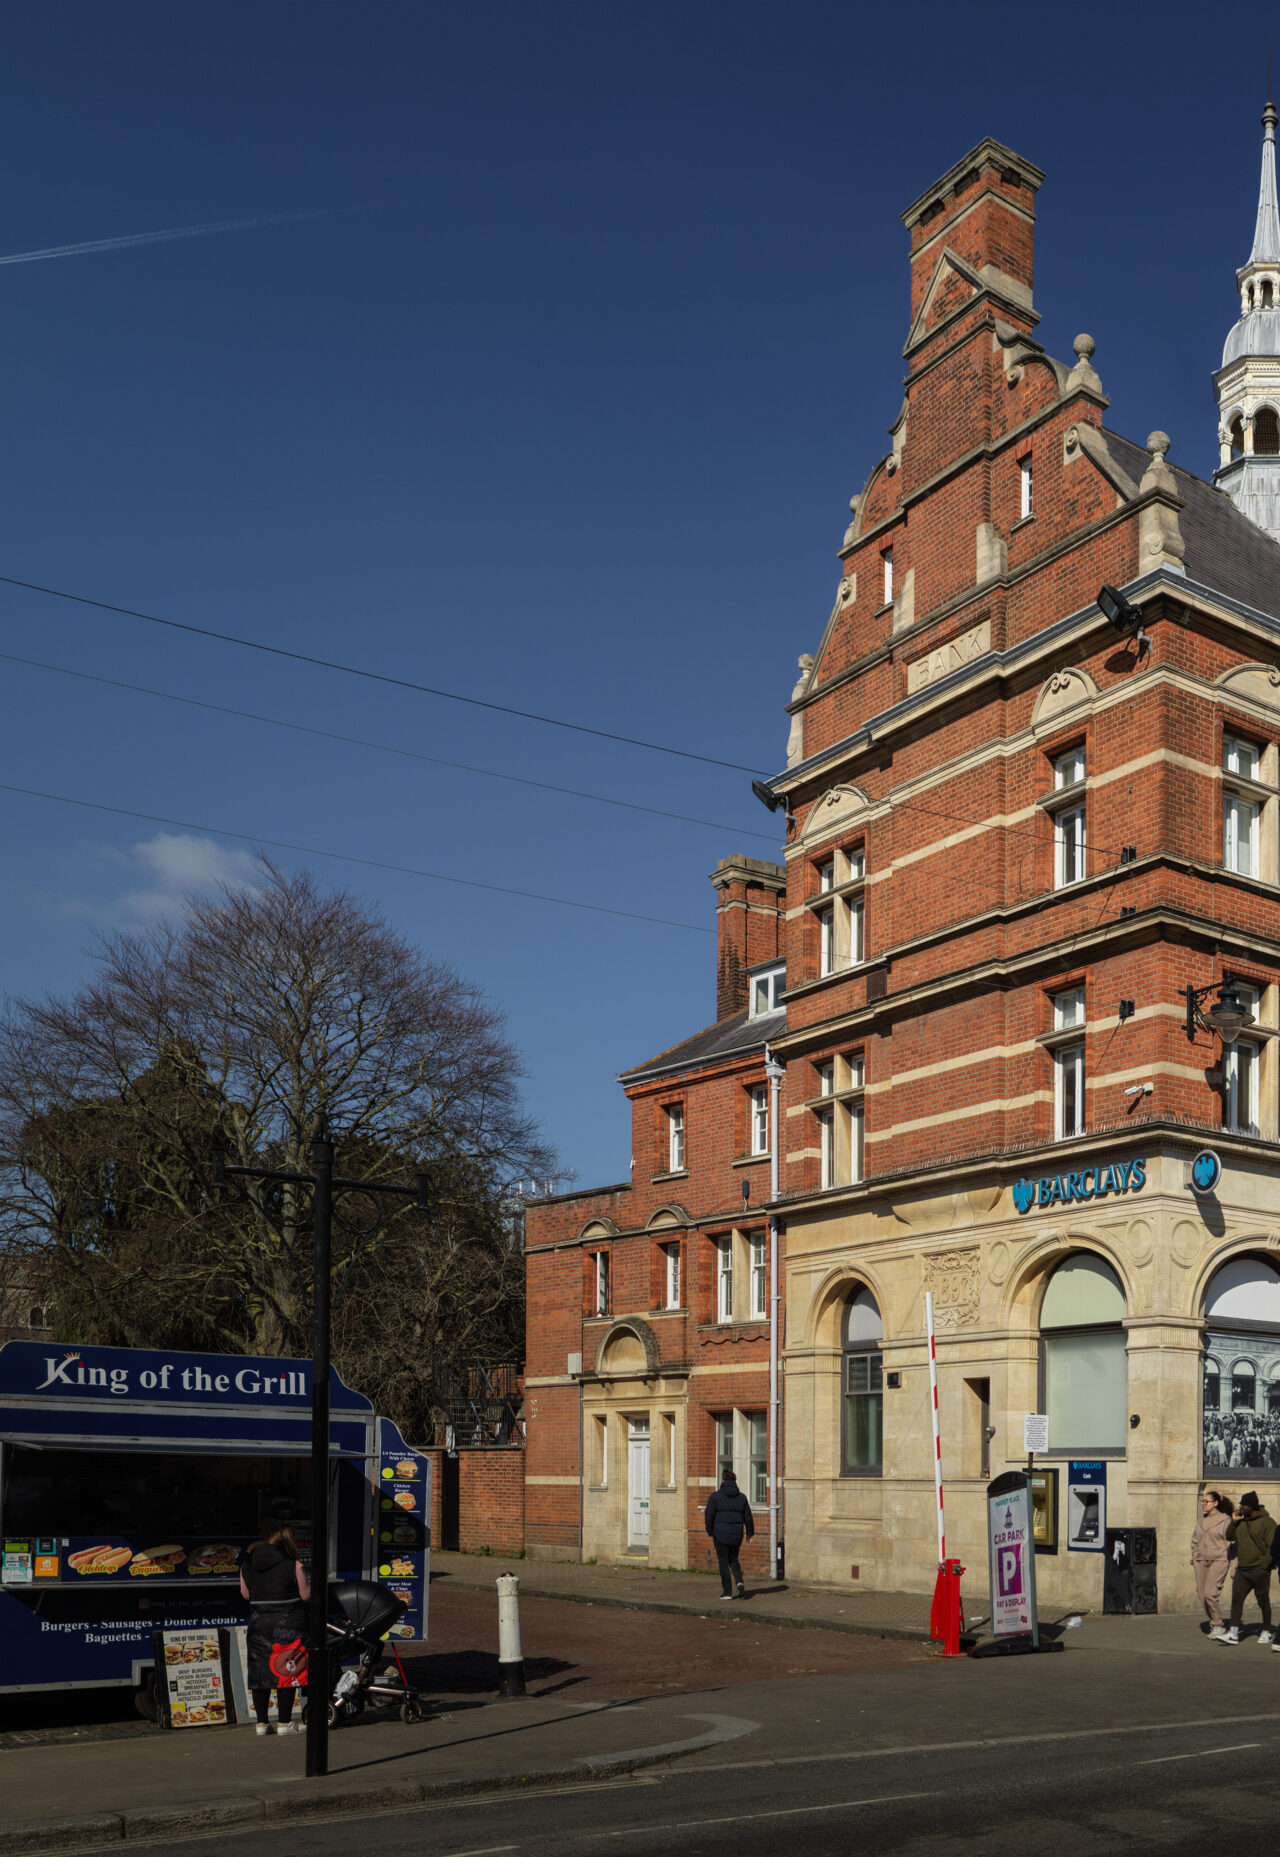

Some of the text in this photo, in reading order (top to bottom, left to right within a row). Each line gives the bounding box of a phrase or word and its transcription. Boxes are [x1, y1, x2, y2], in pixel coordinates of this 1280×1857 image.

[916, 628, 983, 687] BANK
[1037, 1159, 1145, 1205] BARCLAYS
[935, 1277, 969, 1305] 1897
[36, 1355, 308, 1396] King of the Grill
[995, 1495, 1021, 1507] MARKET PLACE
[994, 1528, 1025, 1545] CAR PARK
[79, 1564, 117, 1575] Hotdogs
[1003, 1551, 1017, 1591] P
[996, 1600, 1004, 1609] PAY
[1008, 1597, 1026, 1607] DISPLAY
[41, 1620, 89, 1633] Burgers
[101, 1618, 153, 1631] Sausages
[202, 1615, 237, 1627] Kebab
[86, 1632, 143, 1644] Baguettes
